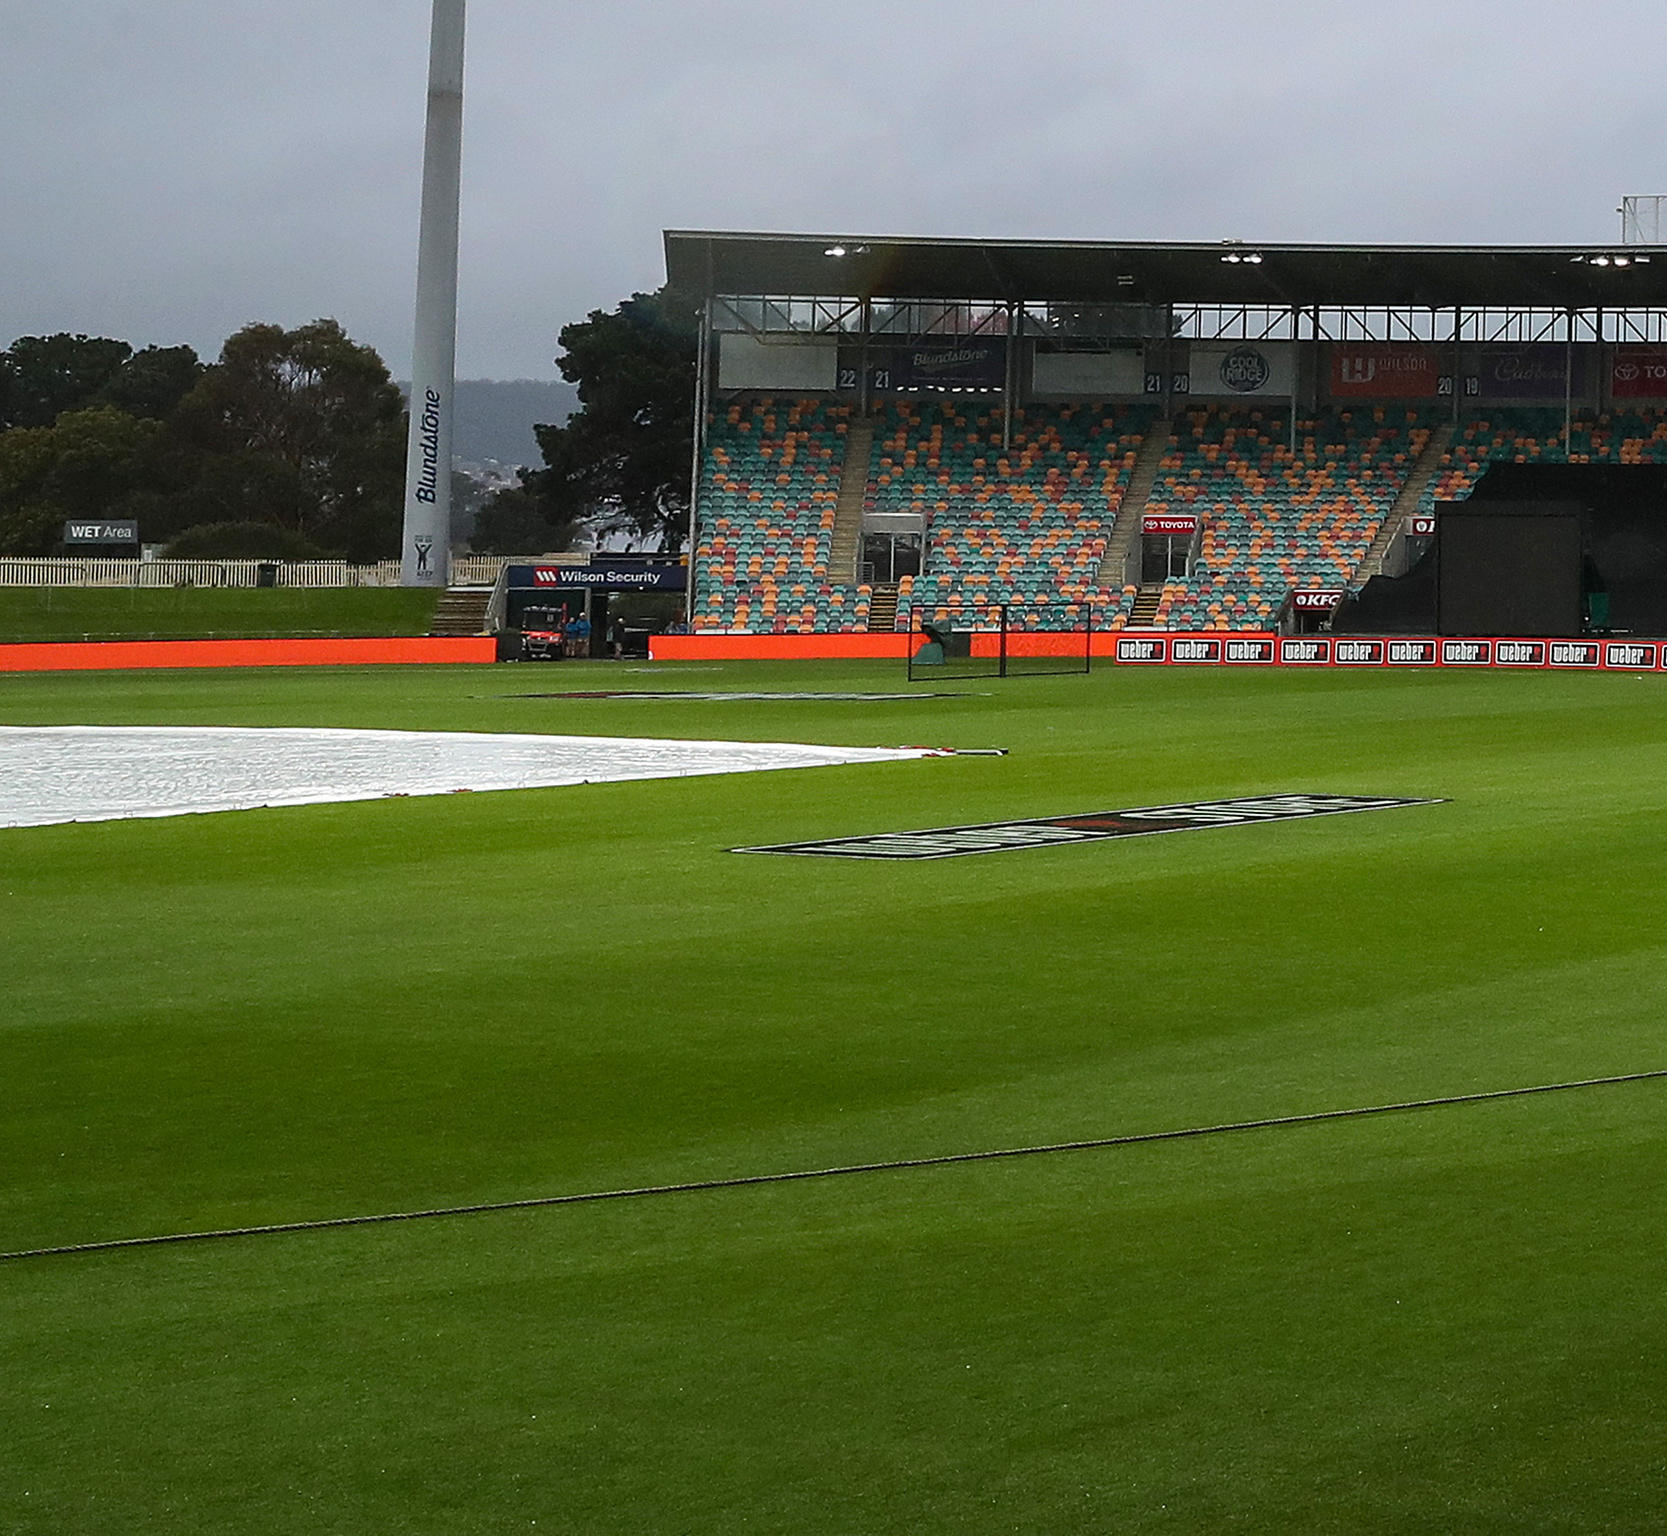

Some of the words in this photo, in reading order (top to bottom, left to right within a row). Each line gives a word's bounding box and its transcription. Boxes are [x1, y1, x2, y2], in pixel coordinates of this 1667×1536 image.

[1229, 356, 1259, 368] COOL
[840, 370, 855, 387] 22
[875, 370, 889, 388] 21
[1147, 375, 1161, 391] 21
[1174, 375, 1189, 391] 20
[1227, 368, 1263, 382] RIDGE
[1438, 377, 1451, 394] 20
[416, 388, 440, 504] Blundstone
[71, 525, 102, 538] WET
[103, 526, 132, 538] Area
[1160, 521, 1194, 529] TOYOTA
[560, 570, 604, 583] Wilson
[606, 570, 661, 585] Security
[1306, 594, 1341, 607] KFC
[1120, 639, 1154, 659] weber
[1175, 639, 1209, 659] weber
[1229, 639, 1262, 659] weber
[1285, 639, 1318, 659] weber
[1339, 641, 1372, 660] weber
[1391, 642, 1424, 661] weber
[1446, 642, 1479, 662] weber
[1499, 643, 1533, 662] weber
[1553, 643, 1587, 663] weber
[1609, 644, 1644, 665] weber
